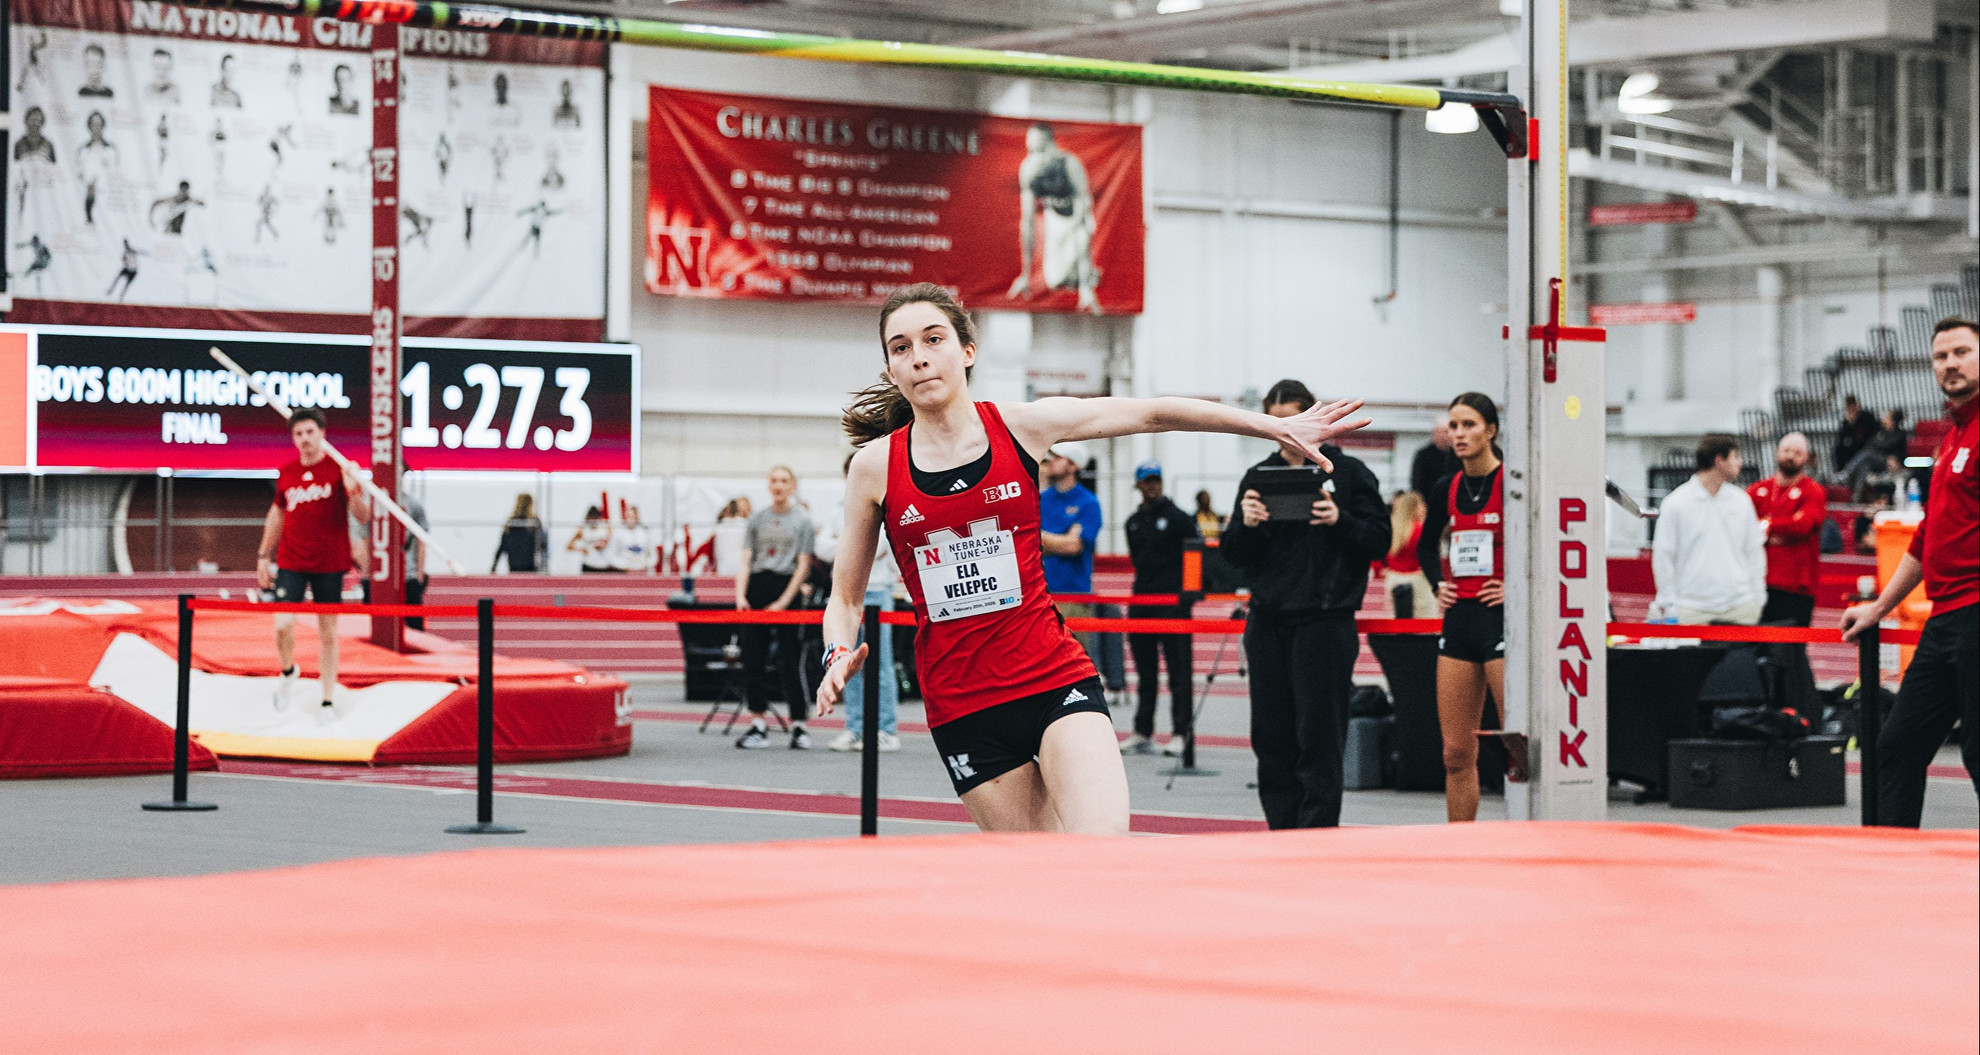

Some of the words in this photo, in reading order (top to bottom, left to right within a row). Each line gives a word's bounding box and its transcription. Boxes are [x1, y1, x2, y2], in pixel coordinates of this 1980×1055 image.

[131, 1, 300, 42] NATIONAL
[312, 15, 489, 57] CHAPIONS
[717, 105, 854, 146] CHARLES
[866, 117, 981, 156] GREENE
[374, 160, 394, 182] 12
[751, 169, 794, 193] TIME
[858, 178, 949, 200] CHAMPION
[742, 196, 758, 215] 7
[763, 197, 803, 219] TIME
[750, 221, 790, 243] TIME
[859, 228, 952, 251] CHAMPION
[374, 258, 394, 281] 10
[654, 230, 707, 291] N
[36, 364, 104, 402] BOYS
[107, 366, 181, 404] 800M
[184, 368, 248, 406] HIGH
[250, 370, 351, 408] SCHOOL
[372, 306, 394, 465] HUSKERS
[400, 361, 592, 451] 1:27.3
[161, 411, 228, 444] FINAL
[898, 514, 926, 527] adidas
[923, 547, 941, 566] N
[948, 535, 1002, 553] NEBRASKA
[954, 545, 1000, 561] TUNE-UP
[956, 562, 980, 580] ELA
[943, 576, 998, 599] VELEPEC
[1557, 497, 1592, 768] POLANIK
[1062, 695, 1089, 706] adidas
